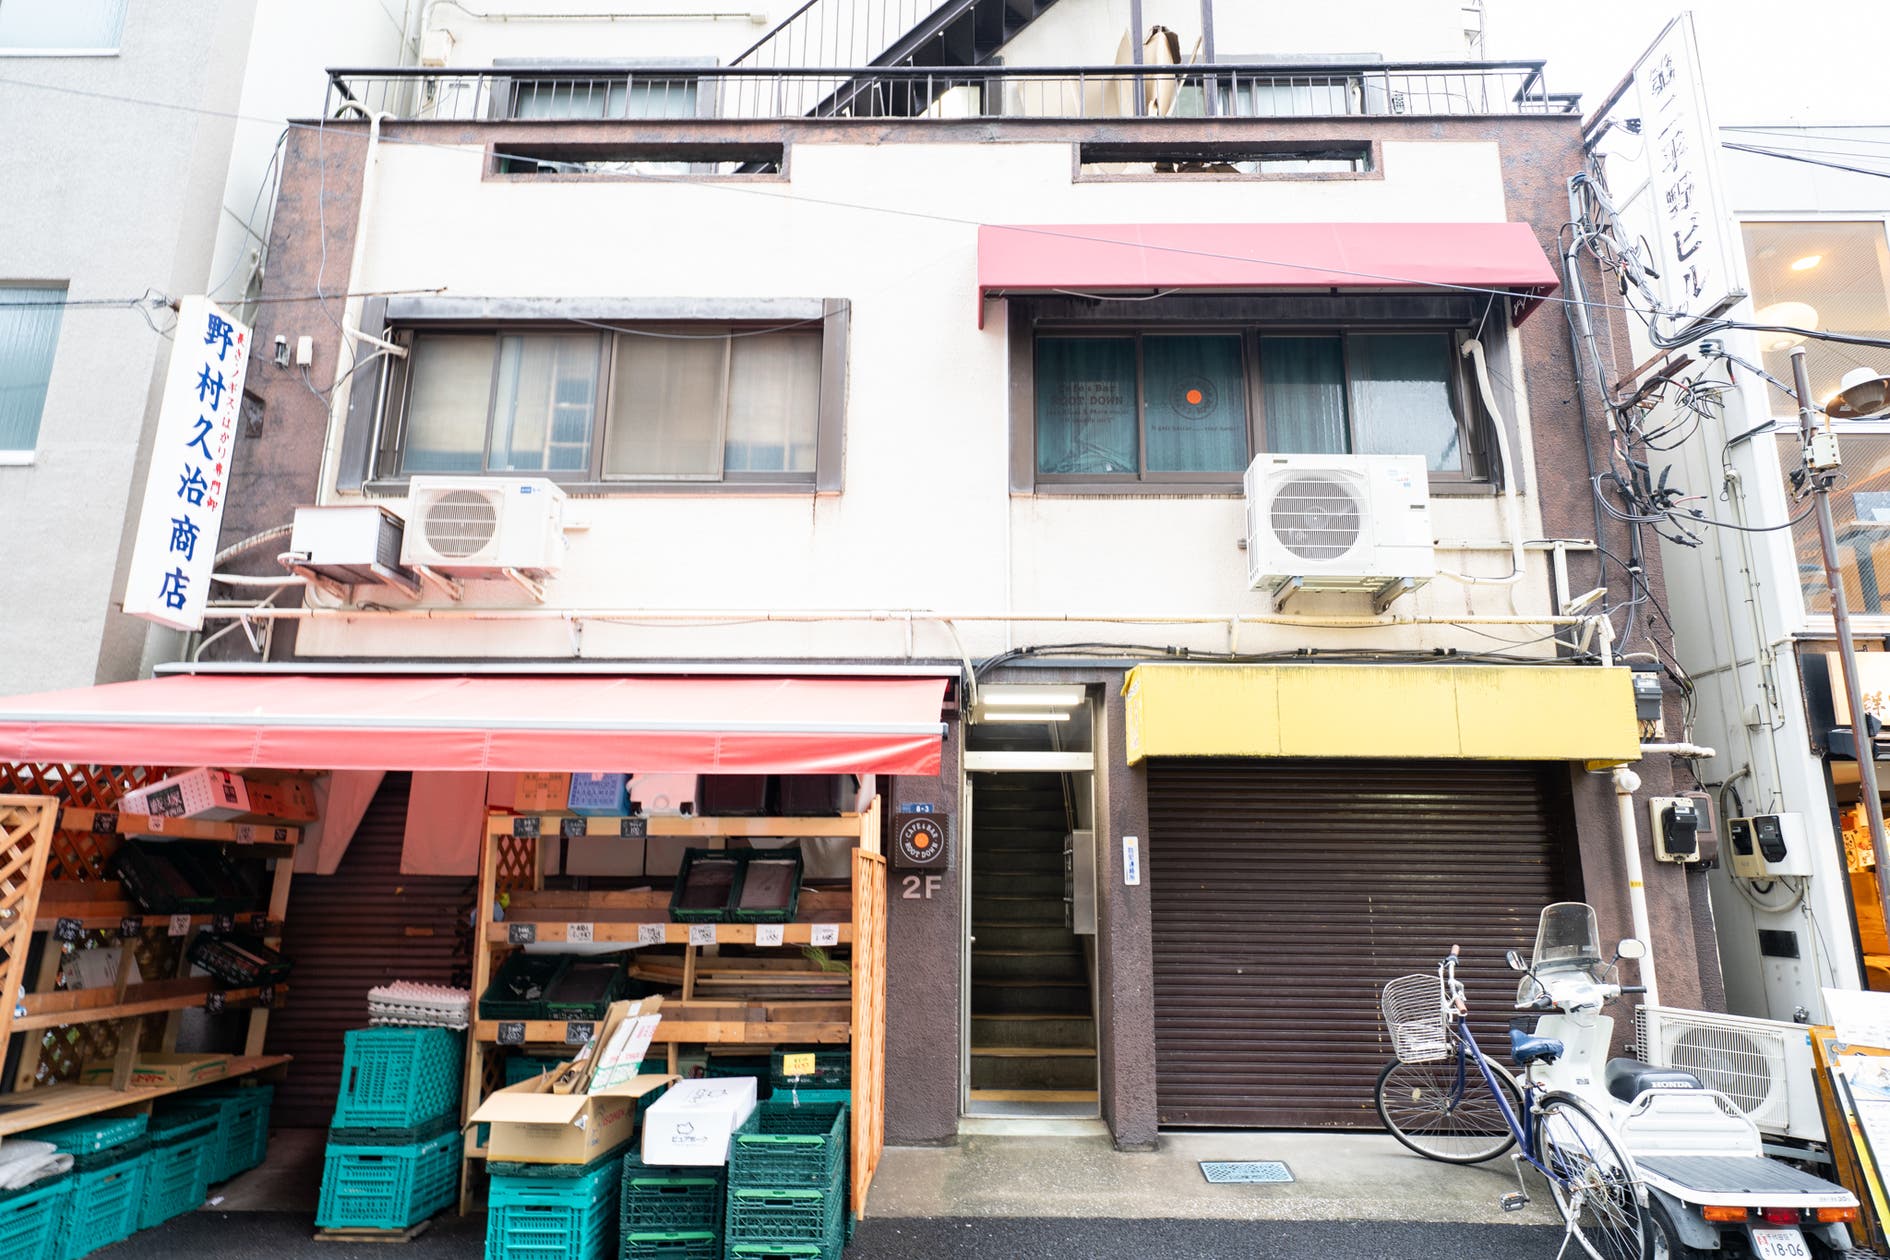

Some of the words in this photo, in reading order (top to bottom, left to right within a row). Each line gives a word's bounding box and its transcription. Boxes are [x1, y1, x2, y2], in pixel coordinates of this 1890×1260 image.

[158, 313, 234, 611] 野村久治商店
[921, 842, 939, 858] DOWN
[902, 875, 942, 899] 2F
[1651, 1081, 1694, 1089] HONDA
